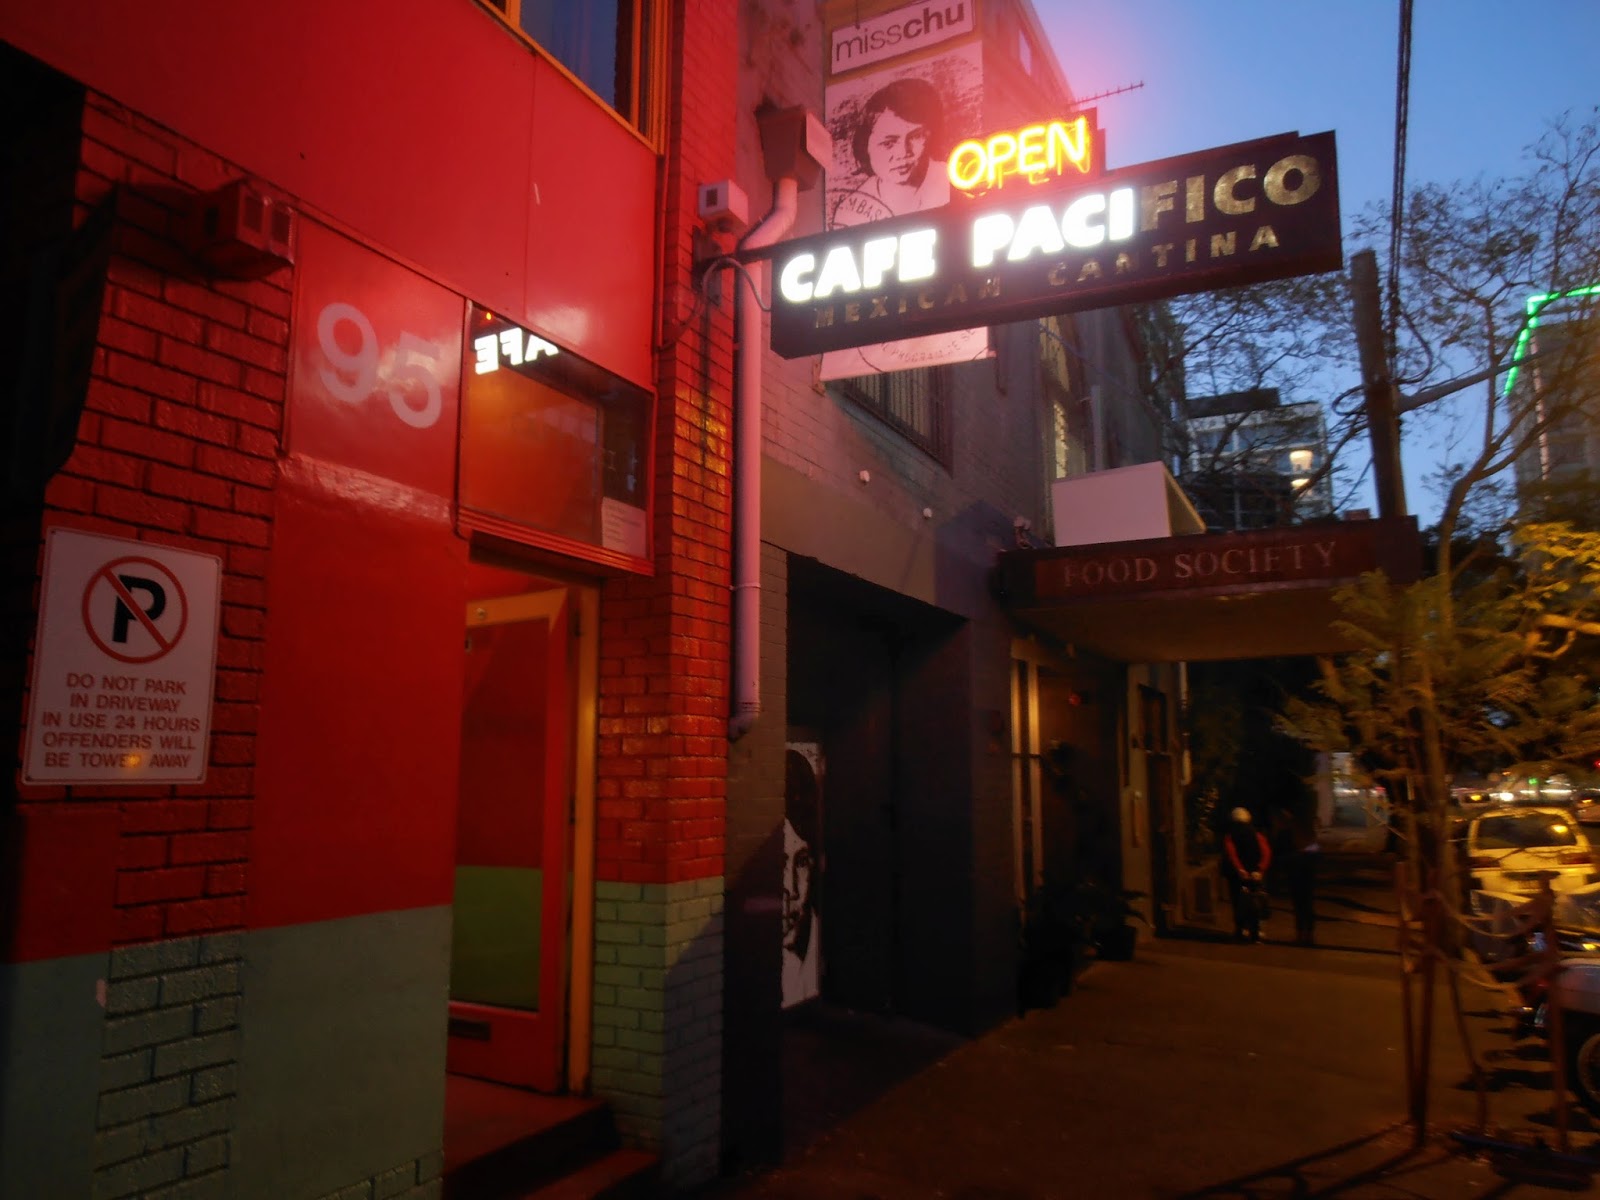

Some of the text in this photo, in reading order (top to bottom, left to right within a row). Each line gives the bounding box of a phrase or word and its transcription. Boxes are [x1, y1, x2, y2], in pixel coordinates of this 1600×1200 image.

[836, 2, 965, 62] misschu
[948, 115, 1090, 190] OPEN
[838, 193, 884, 223] EMBAS
[780, 154, 1322, 303] CAFE PACIFICO
[815, 224, 1280, 329] MEXICAN CANTINA
[316, 302, 443, 429] 95
[1063, 541, 1338, 588] FOOD SOCIETY
[66, 672, 188, 696] DO NOT PARK
[42, 711, 201, 733] IN USE 24 HOURS
[70, 693, 182, 714] IN DRIVEWAY
[42, 732, 197, 751] OFFENDERS WILL
[44, 752, 71, 768] BE
[150, 753, 193, 770] AWAY
